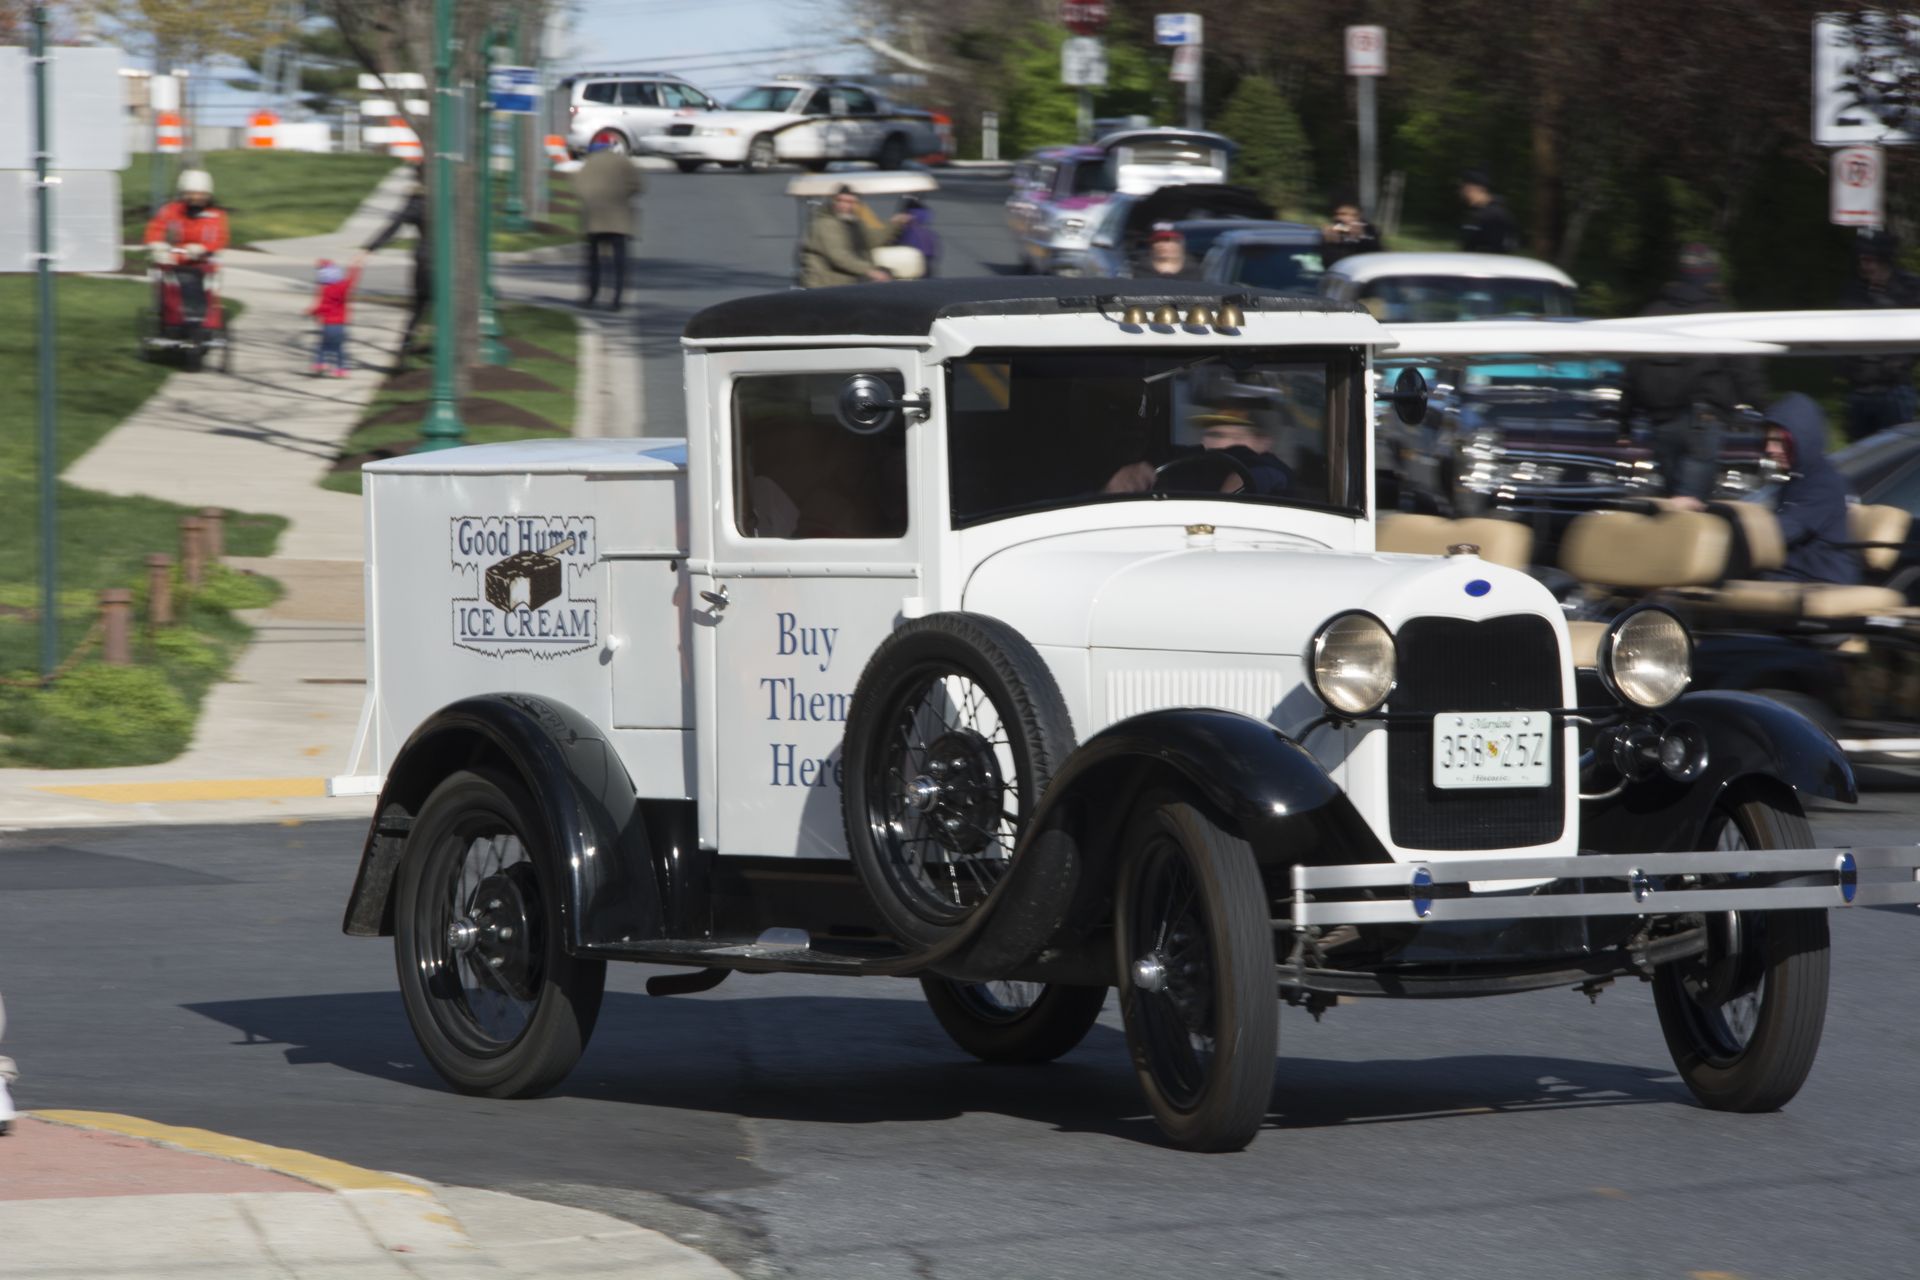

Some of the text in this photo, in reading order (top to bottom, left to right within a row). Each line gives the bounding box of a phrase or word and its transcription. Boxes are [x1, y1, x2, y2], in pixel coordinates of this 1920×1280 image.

[458, 519, 588, 556] Good Humor
[459, 607, 591, 638] ICE CREAM
[776, 612, 839, 672] Buy
[759, 677, 855, 722] Them
[1440, 734, 1484, 769] 358
